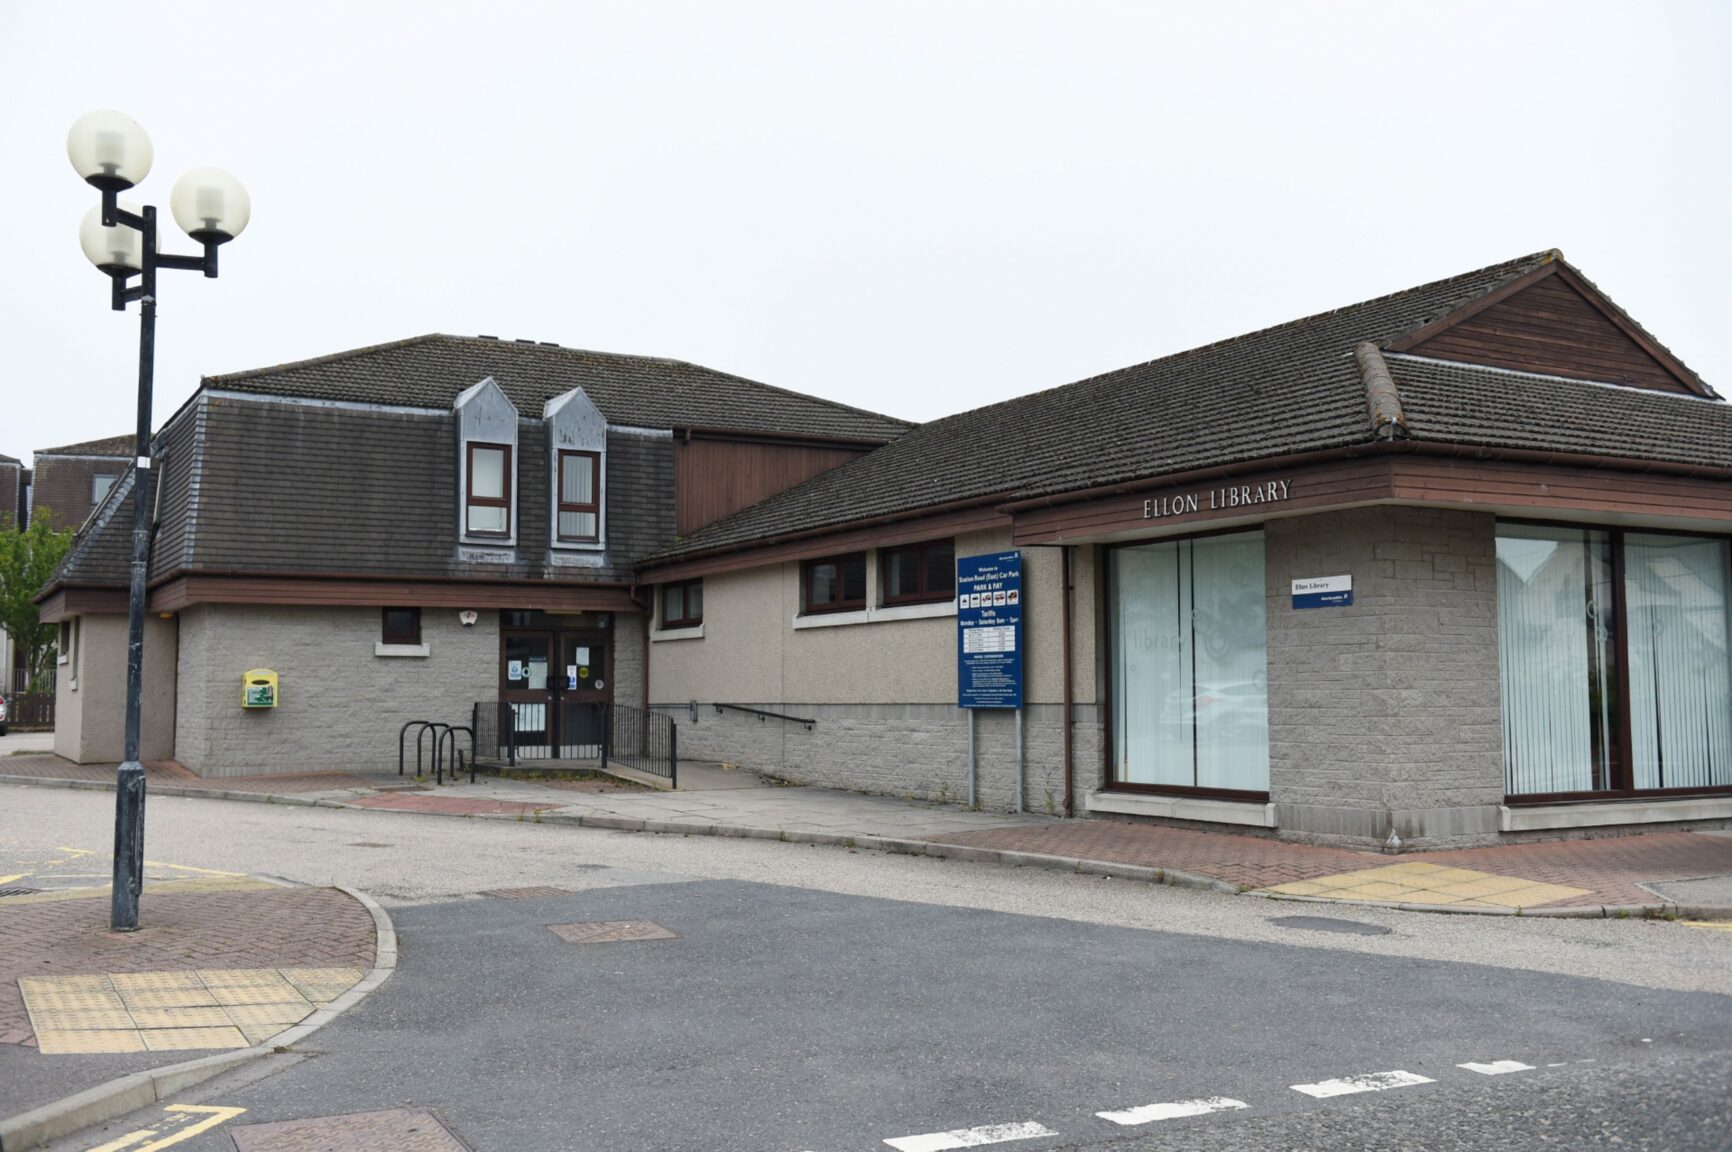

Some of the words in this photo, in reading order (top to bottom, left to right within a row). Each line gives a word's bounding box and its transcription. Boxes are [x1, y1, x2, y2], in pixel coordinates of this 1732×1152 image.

[1144, 493, 1198, 519] ELLON
[1210, 479, 1292, 509] LIBRARY
[1309, 582, 1329, 590] Library
